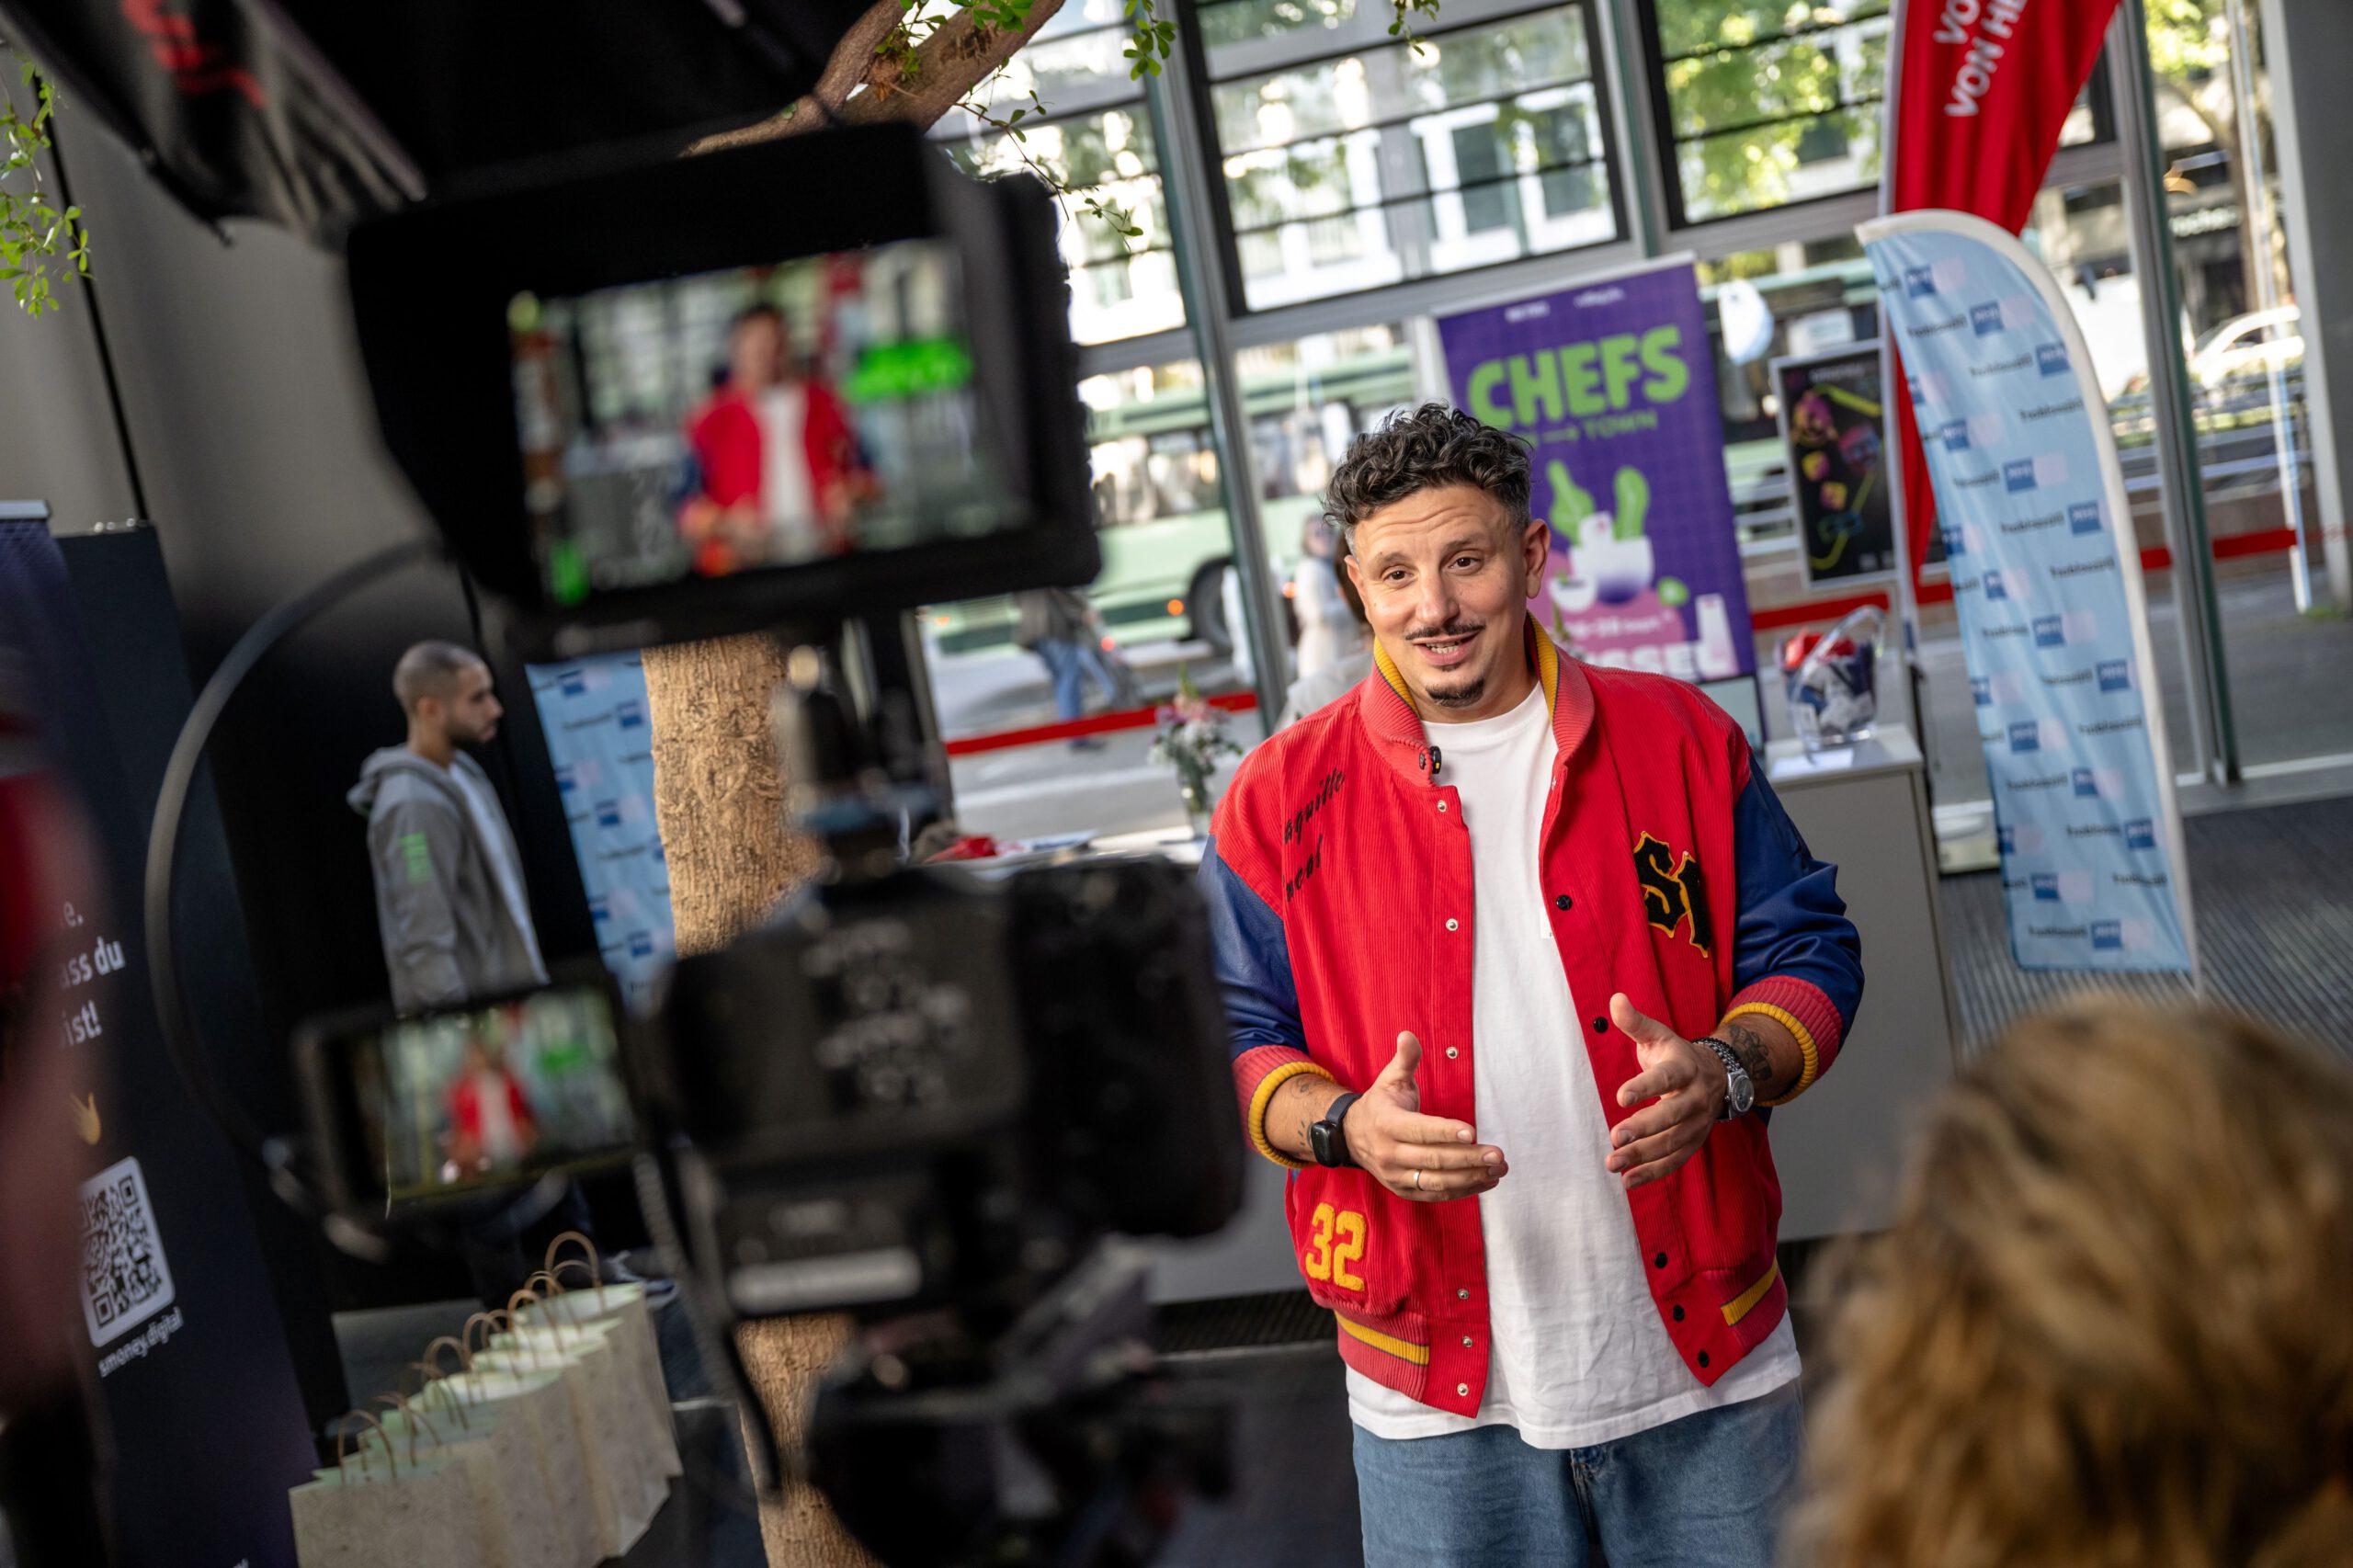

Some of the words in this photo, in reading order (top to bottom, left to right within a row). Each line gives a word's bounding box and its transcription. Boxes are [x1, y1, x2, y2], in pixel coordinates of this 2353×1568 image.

[1944, 36, 2005, 117] VON
[1467, 324, 1689, 432] CHEFS
[94, 935, 126, 976] du
[1305, 1201, 1367, 1291] 32
